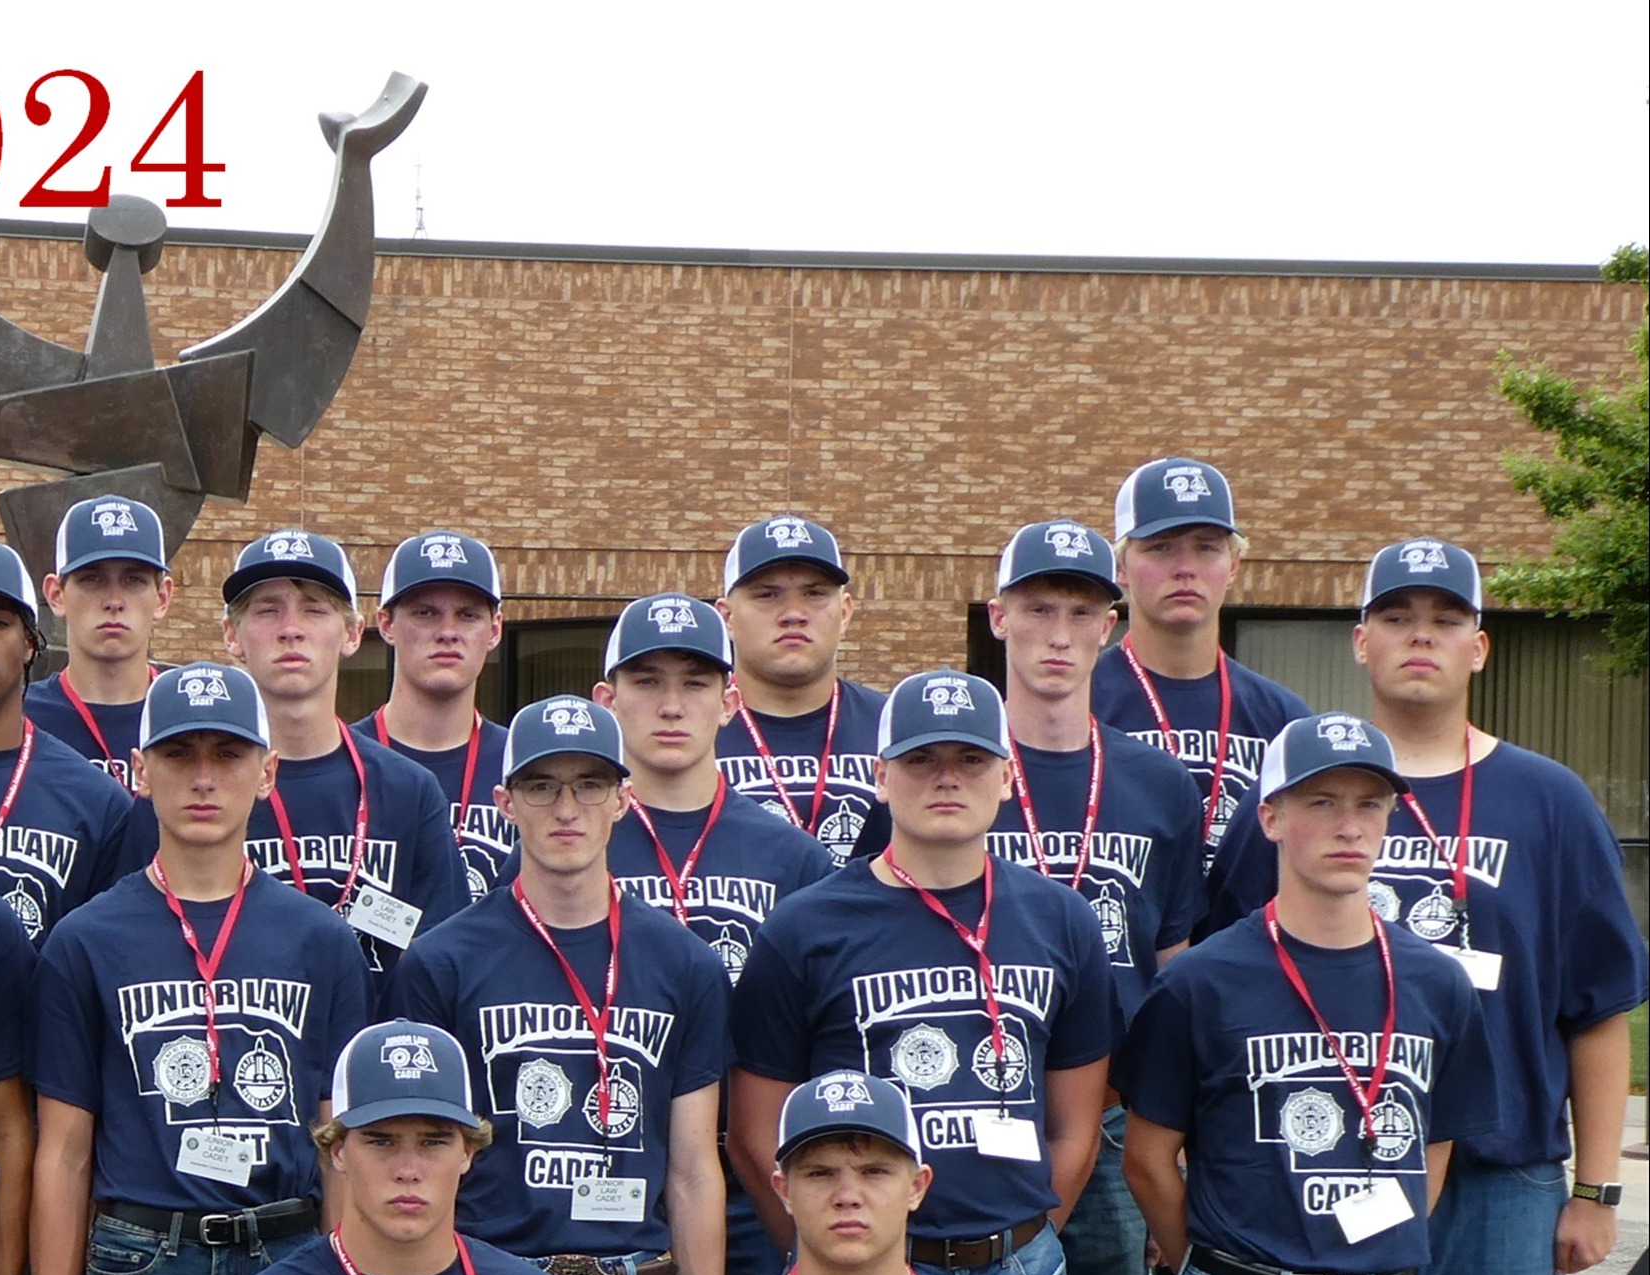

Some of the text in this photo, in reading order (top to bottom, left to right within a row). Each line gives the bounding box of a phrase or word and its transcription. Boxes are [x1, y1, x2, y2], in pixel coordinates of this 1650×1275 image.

[5, 824, 78, 889] LAW
[1092, 831, 1153, 888] LAW
[706, 876, 776, 923] LAW
[118, 978, 311, 1043] JUNIOR LAW
[852, 966, 980, 1030] JUNIOR
[606, 1006, 675, 1067] LAW
[1246, 1031, 1369, 1090] JUNIOR
